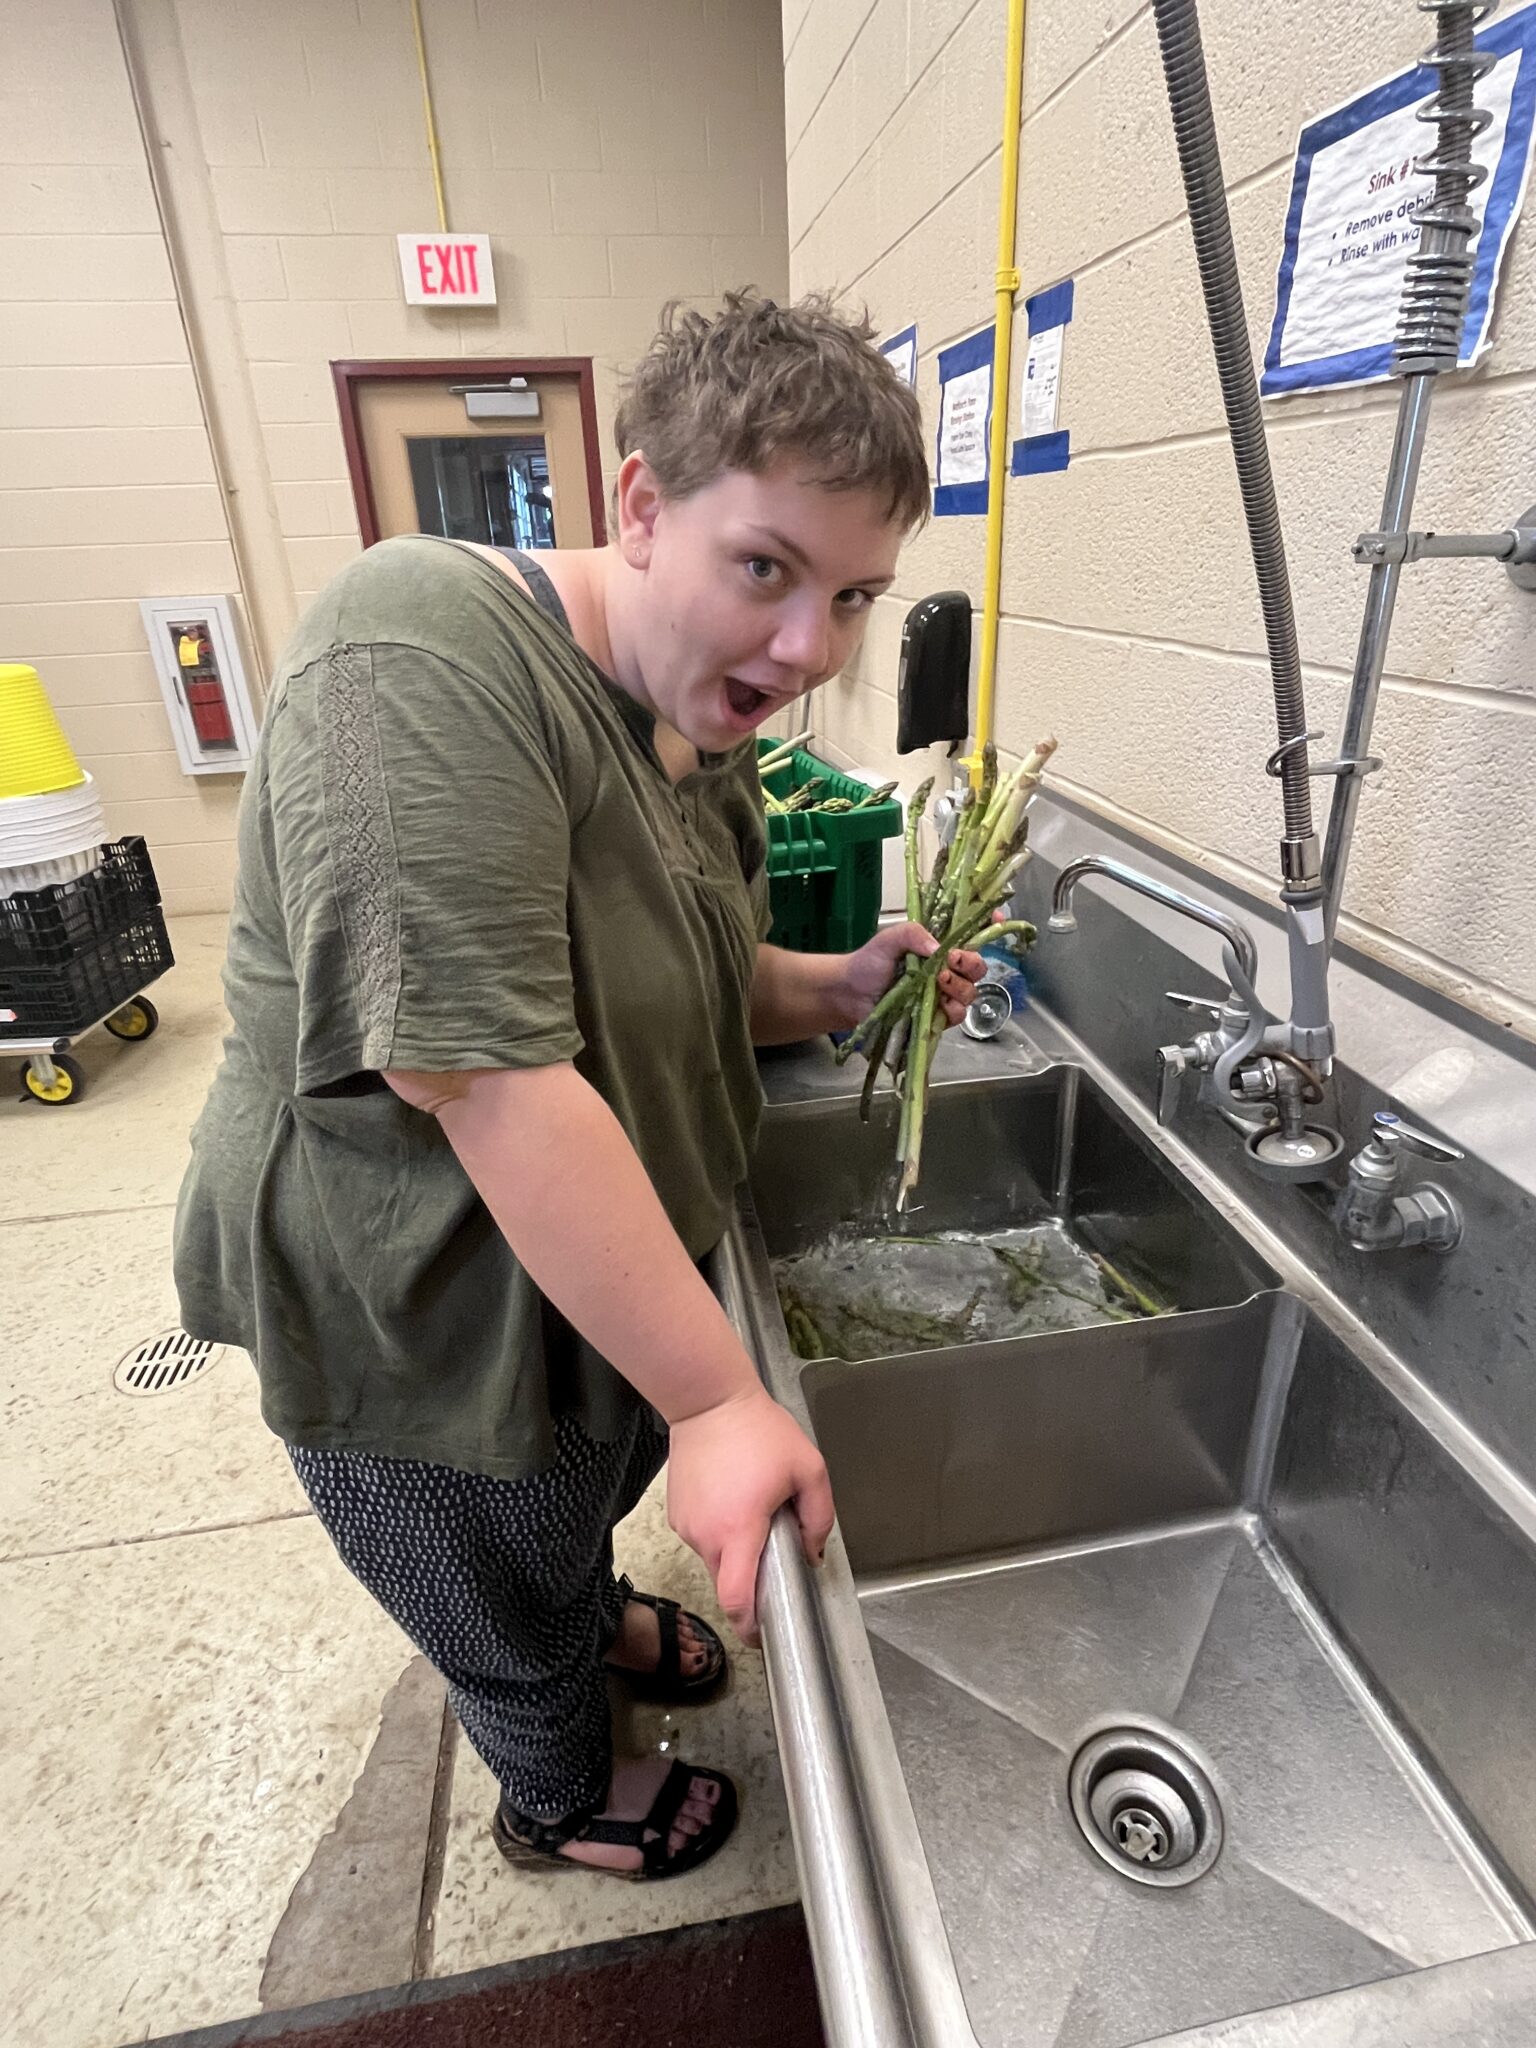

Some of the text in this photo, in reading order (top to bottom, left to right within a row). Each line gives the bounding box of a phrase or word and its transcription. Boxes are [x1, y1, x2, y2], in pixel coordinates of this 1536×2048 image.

[1367, 166, 1398, 195] Sink
[1344, 190, 1435, 238] Remove debri
[1340, 244, 1369, 263] Rinse
[1372, 231, 1398, 254] with
[416, 244, 479, 294] EXIT
